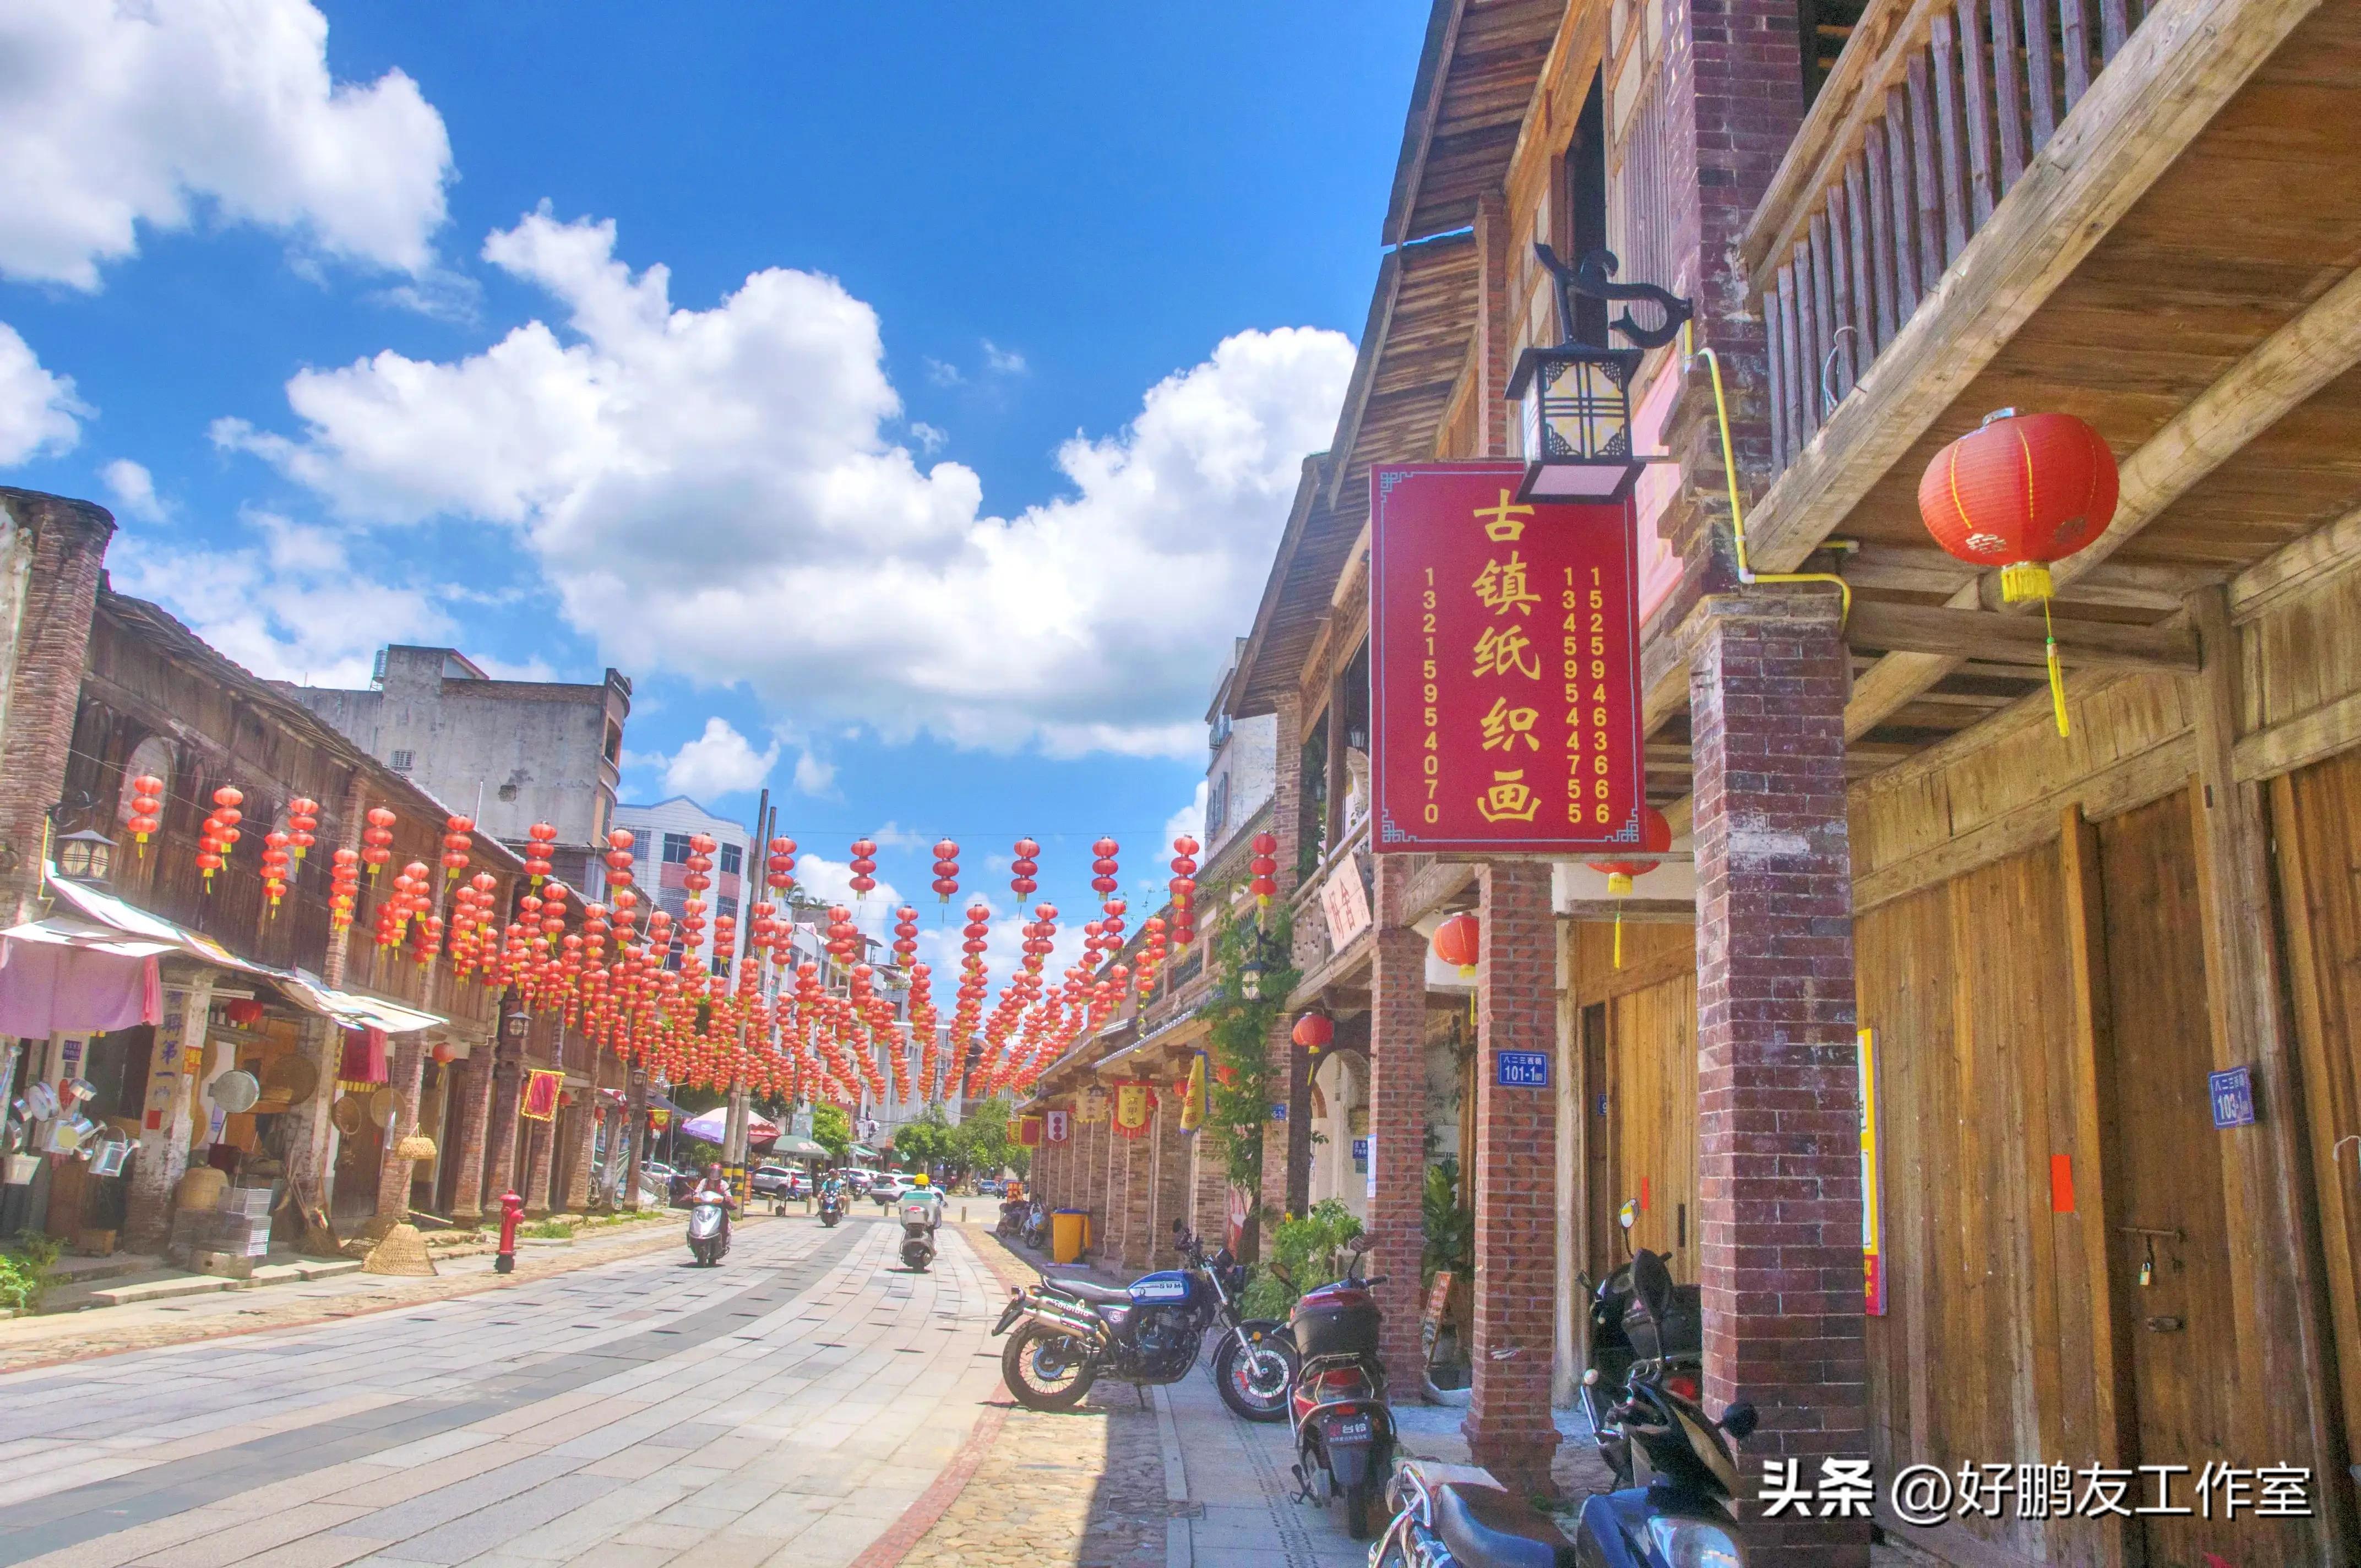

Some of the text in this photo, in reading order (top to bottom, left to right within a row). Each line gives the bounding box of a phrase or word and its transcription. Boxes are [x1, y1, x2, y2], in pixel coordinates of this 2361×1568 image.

[1423, 567, 1439, 823] 13215954070
[1472, 488, 1541, 823] 古镇纸织画
[1562, 567, 1581, 823] 13459544755
[1590, 567, 1609, 823] 15259463666
